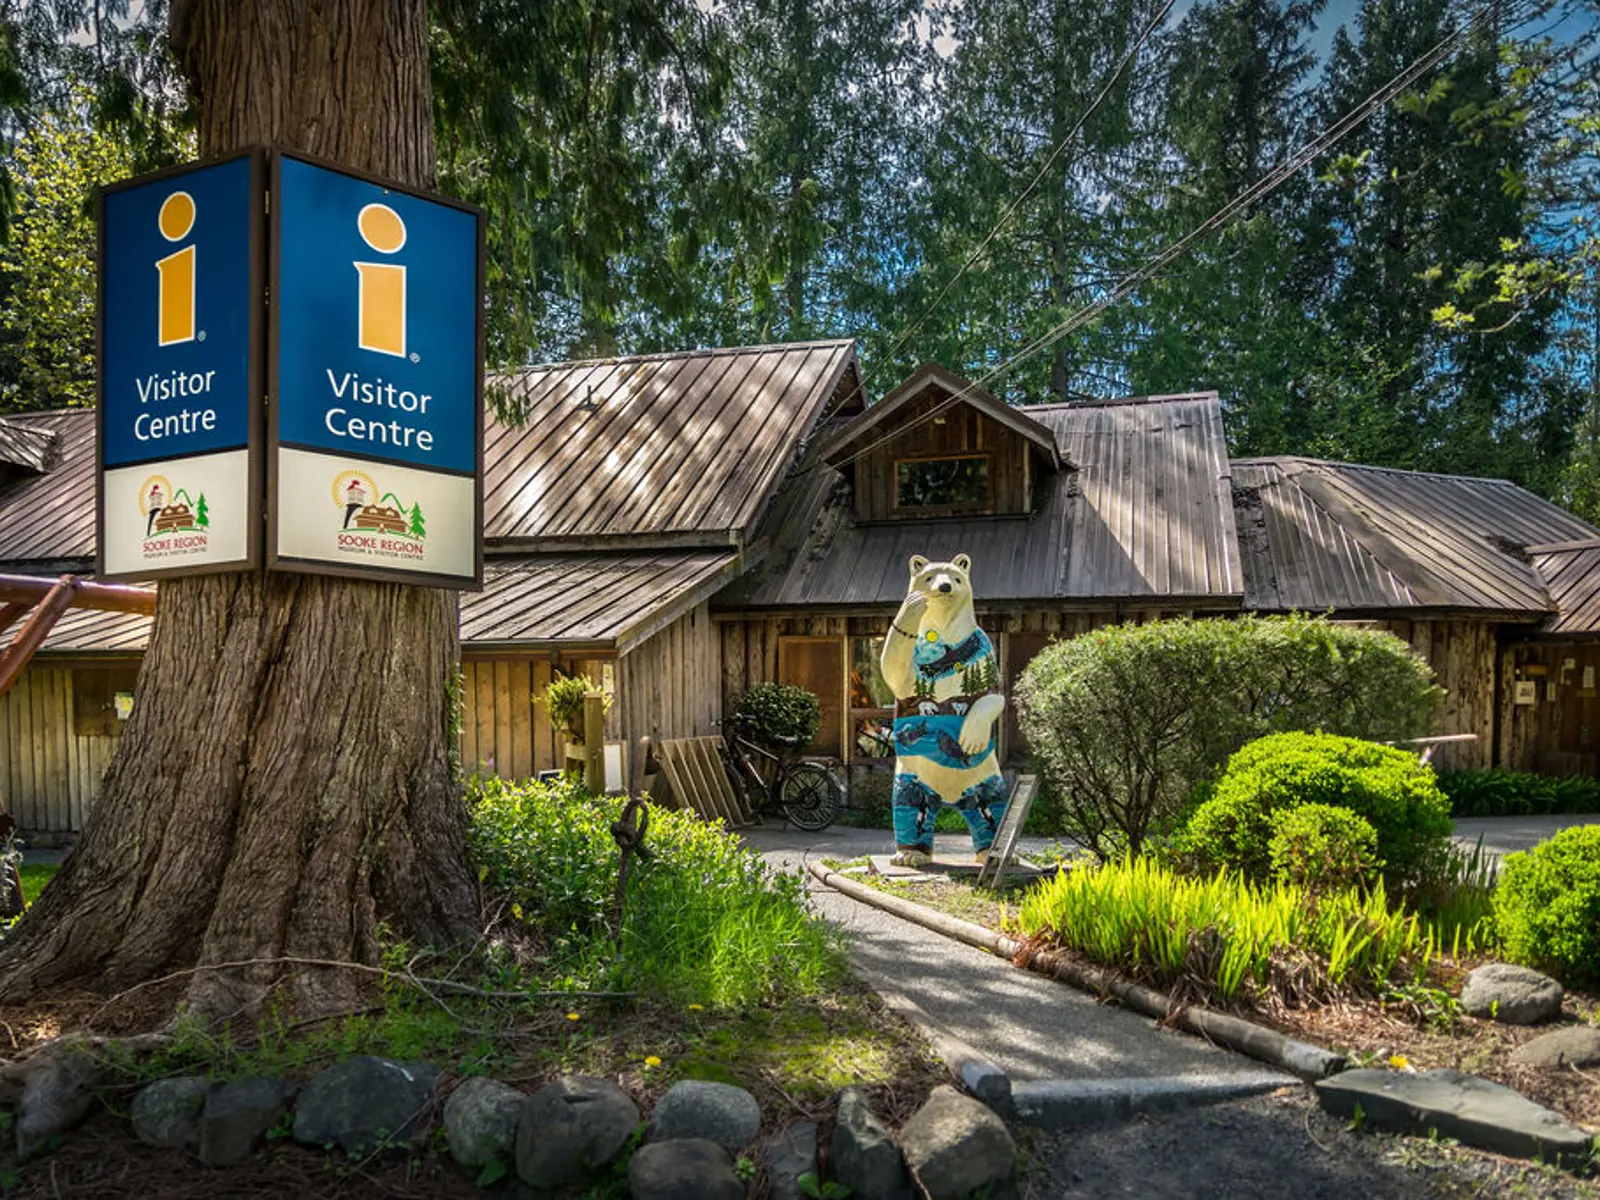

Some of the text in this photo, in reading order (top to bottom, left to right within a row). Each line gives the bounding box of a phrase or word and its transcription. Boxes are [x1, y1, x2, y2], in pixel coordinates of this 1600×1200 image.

[135, 369, 216, 404] Visitor
[326, 368, 432, 414] Visitor
[134, 407, 216, 441] Centre
[325, 407, 434, 451] Centre
[143, 535, 207, 552] SOOKE REGION
[338, 533, 423, 554] SOOKE REGION
